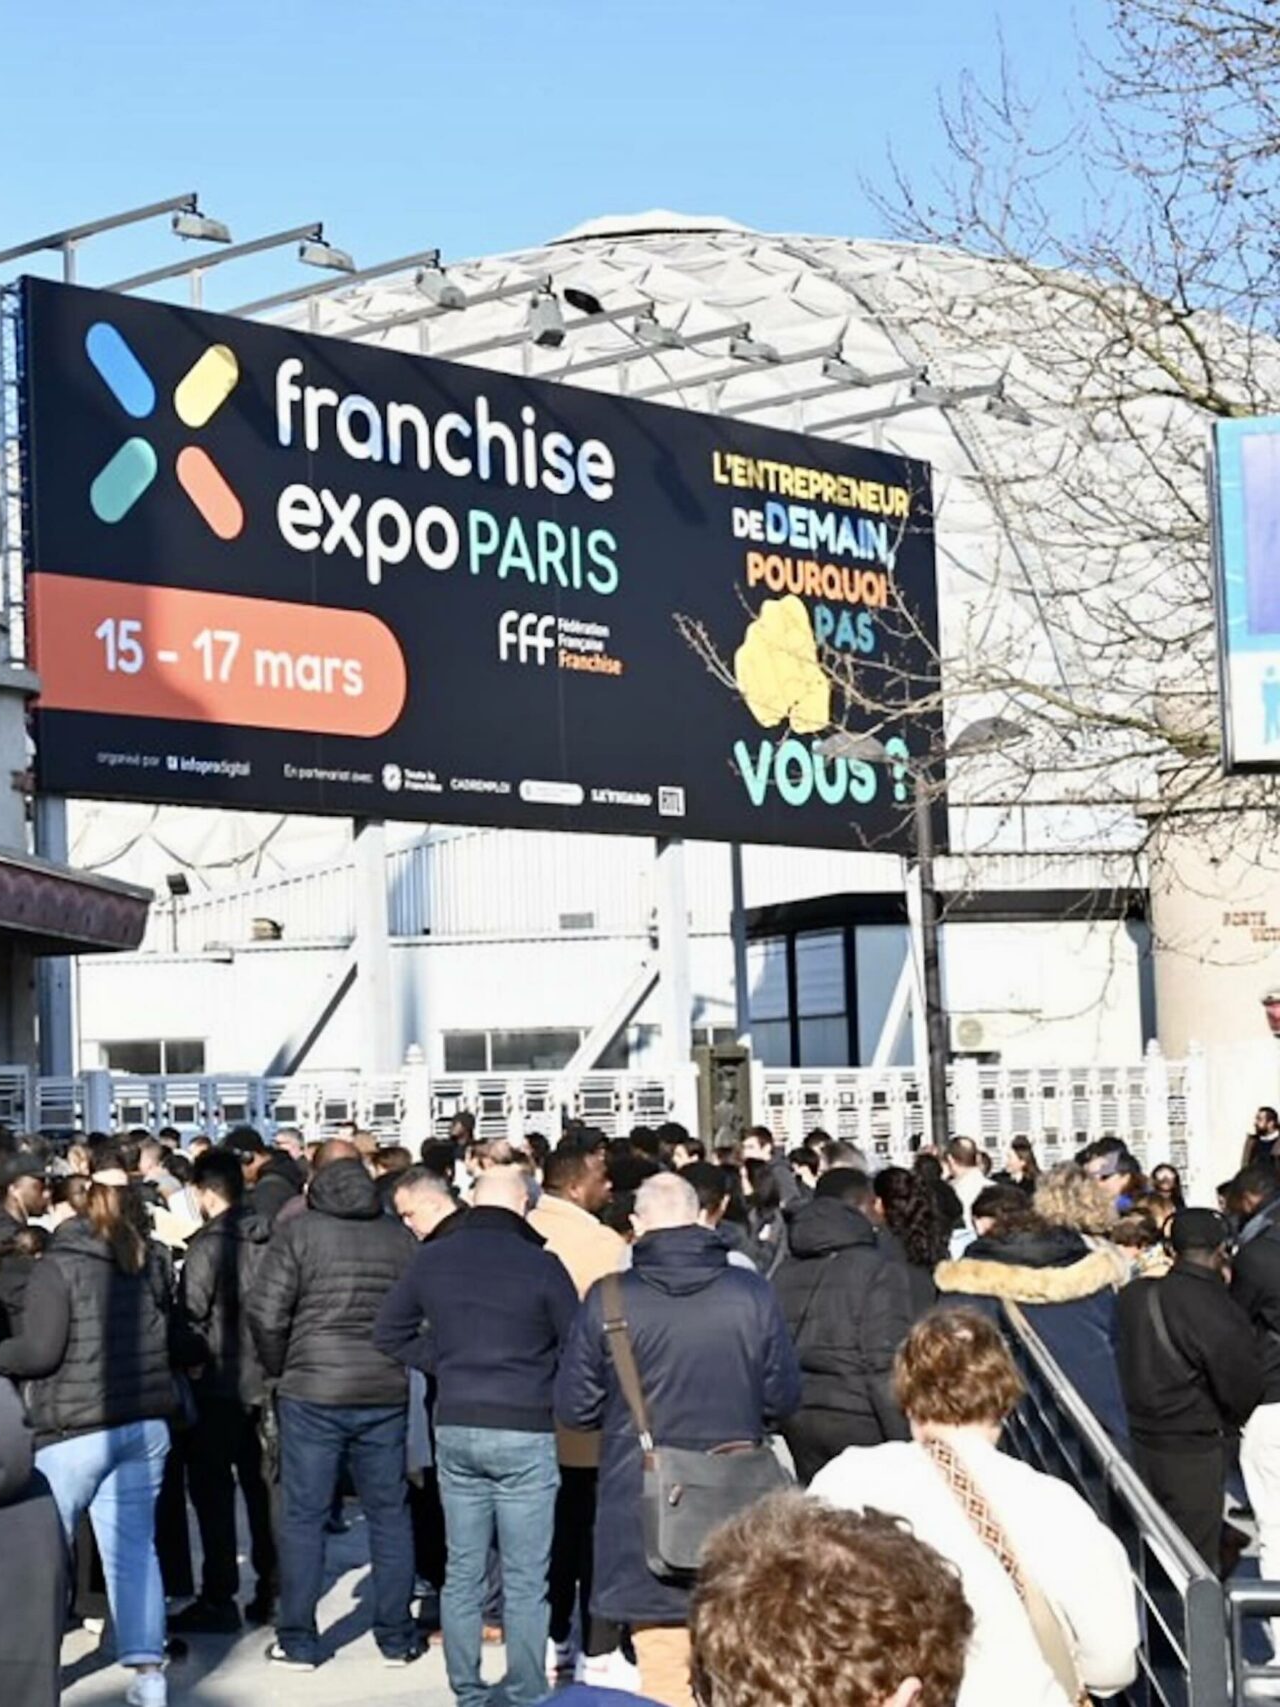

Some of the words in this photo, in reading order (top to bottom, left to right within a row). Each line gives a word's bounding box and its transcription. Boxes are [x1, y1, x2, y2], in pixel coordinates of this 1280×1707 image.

[276, 358, 616, 501] franchise
[712, 450, 911, 518] L'ENTREPRENEUR
[731, 506, 766, 542] DE
[745, 551, 890, 609] POURQUOI
[95, 617, 144, 674] 15
[192, 626, 241, 683] 17
[253, 648, 364, 697] mars
[499, 609, 556, 666] fff
[813, 603, 876, 654] PAS
[557, 648, 623, 676] Franchise
